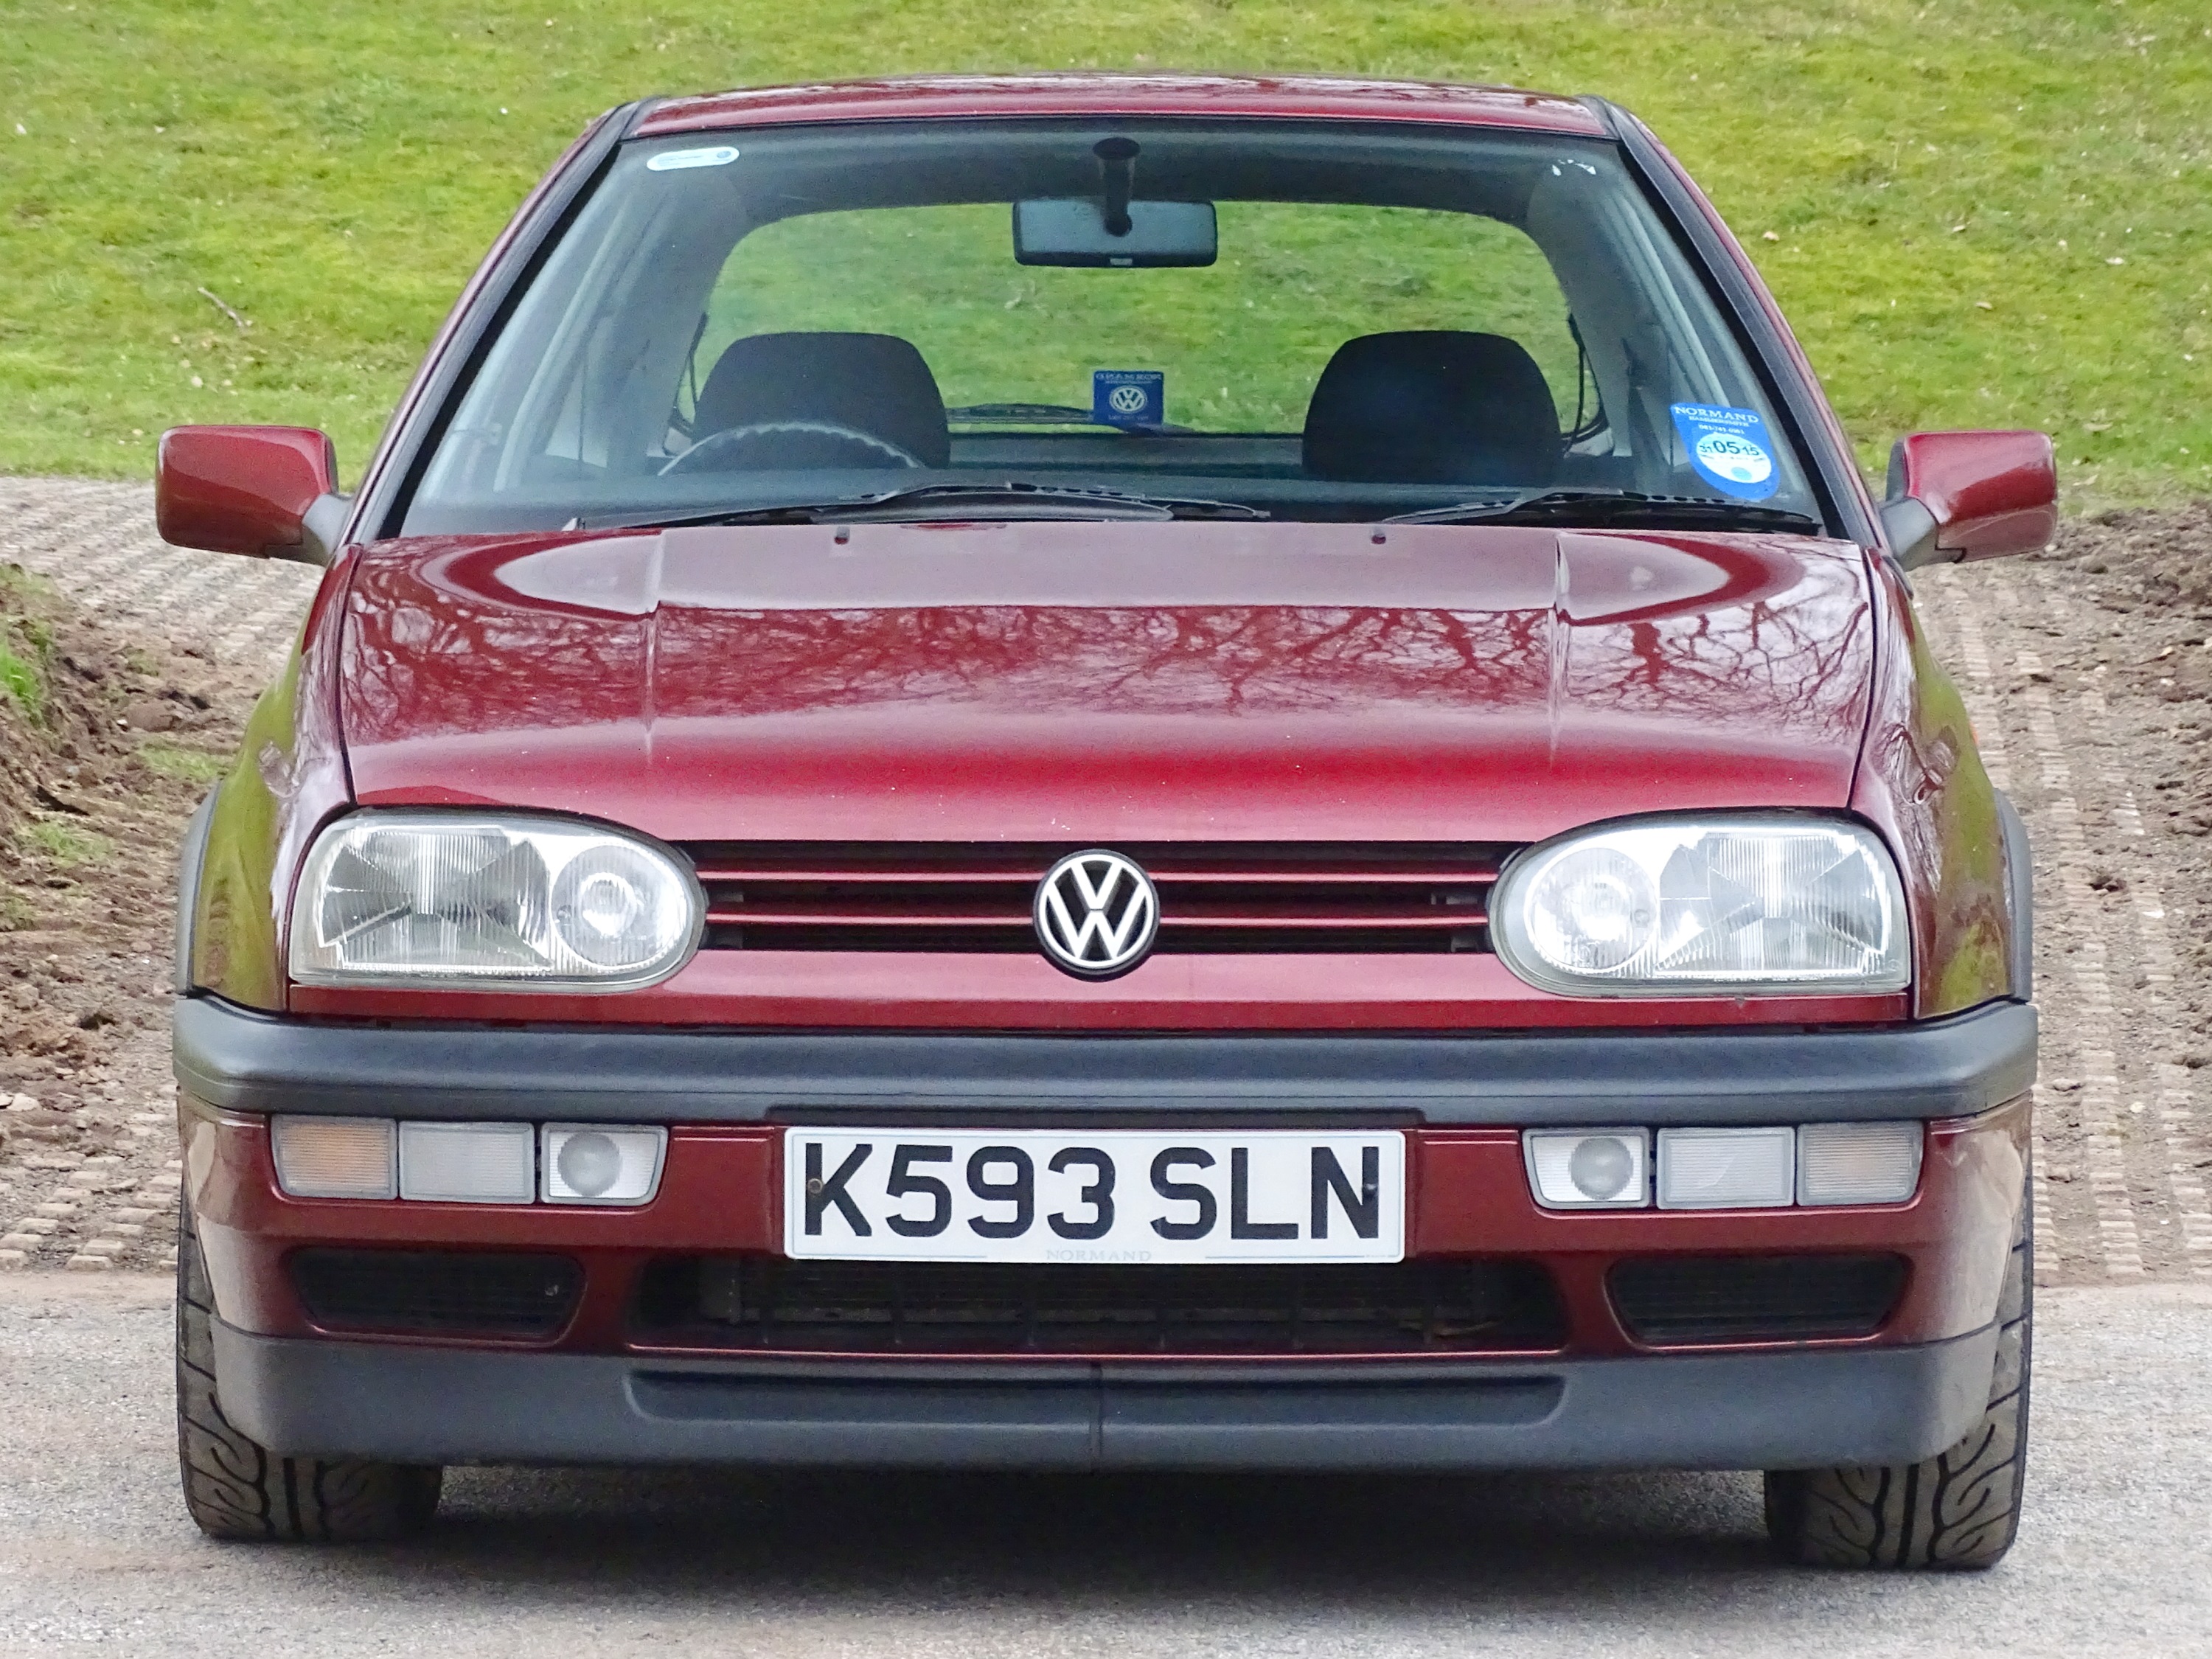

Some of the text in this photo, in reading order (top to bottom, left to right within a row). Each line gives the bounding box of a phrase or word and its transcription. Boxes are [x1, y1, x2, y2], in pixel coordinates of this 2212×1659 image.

[1673, 406, 1759, 423] NORMAND
[1713, 440, 1740, 455] 05
[1742, 445, 1760, 456] 15
[1038, 854, 1155, 968] VW
[804, 1142, 1380, 1241] K593 SLN
[1046, 1249, 1152, 1262] NORMAND
